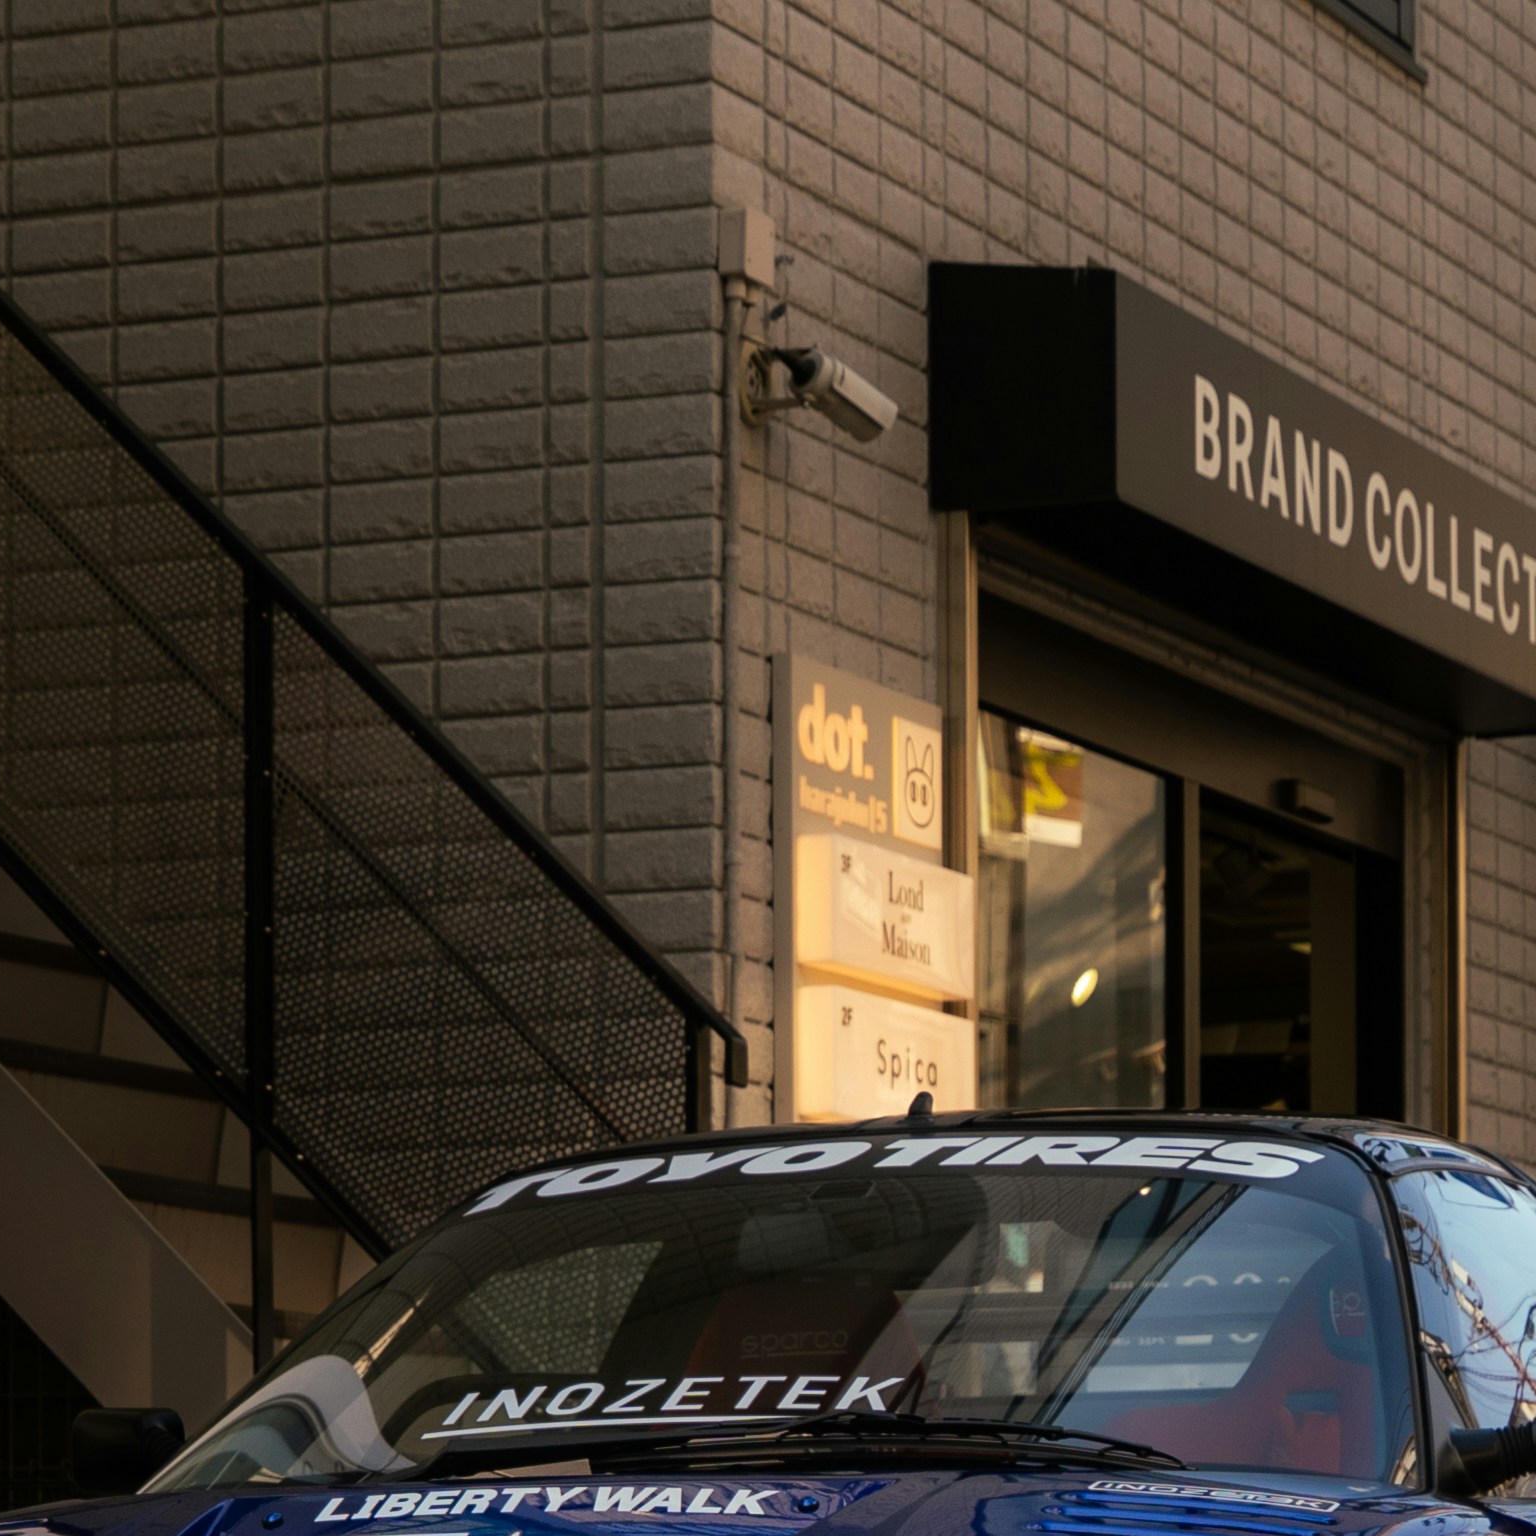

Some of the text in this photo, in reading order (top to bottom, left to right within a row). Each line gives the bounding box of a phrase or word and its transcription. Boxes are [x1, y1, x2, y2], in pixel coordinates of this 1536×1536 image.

[1193, 374, 1355, 549] BRAND
[798, 682, 875, 780] dot.
[841, 854, 852, 874] 3F
[888, 869, 924, 913] Lond
[881, 921, 931, 965] Maison
[842, 1006, 853, 1027] 2F
[877, 1038, 938, 1090] Spica
[464, 1136, 1327, 1217] TOYO TIRES
[740, 1329, 850, 1359] sparco
[443, 1376, 906, 1427] INOZETEK
[314, 1485, 780, 1522] LIBERTY WALK
